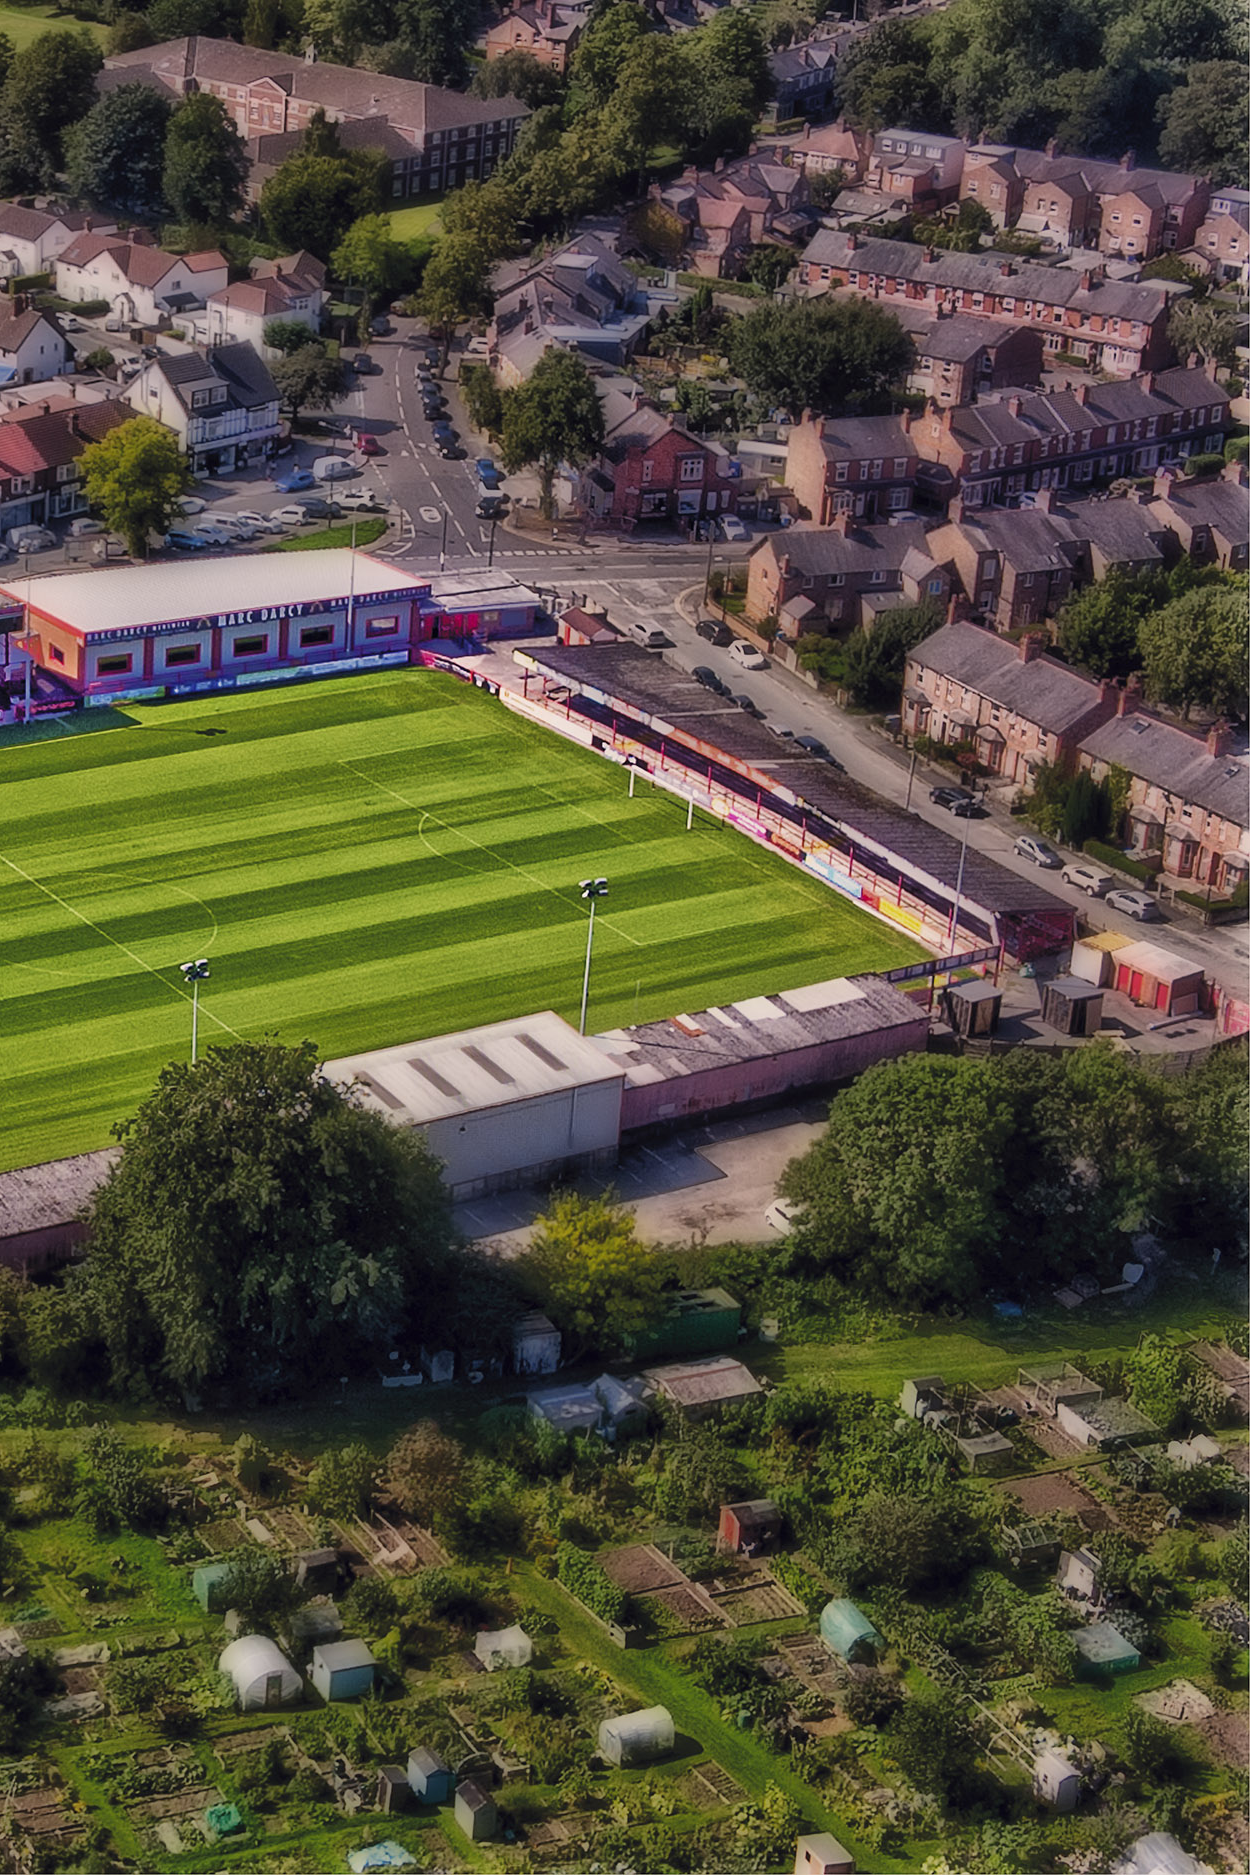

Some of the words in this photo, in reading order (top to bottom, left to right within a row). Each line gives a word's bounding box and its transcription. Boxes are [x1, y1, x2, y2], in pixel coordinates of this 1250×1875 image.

[217, 611, 253, 627] MARC
[261, 604, 303, 621] DARCY
[115, 625, 147, 637] DARCY
